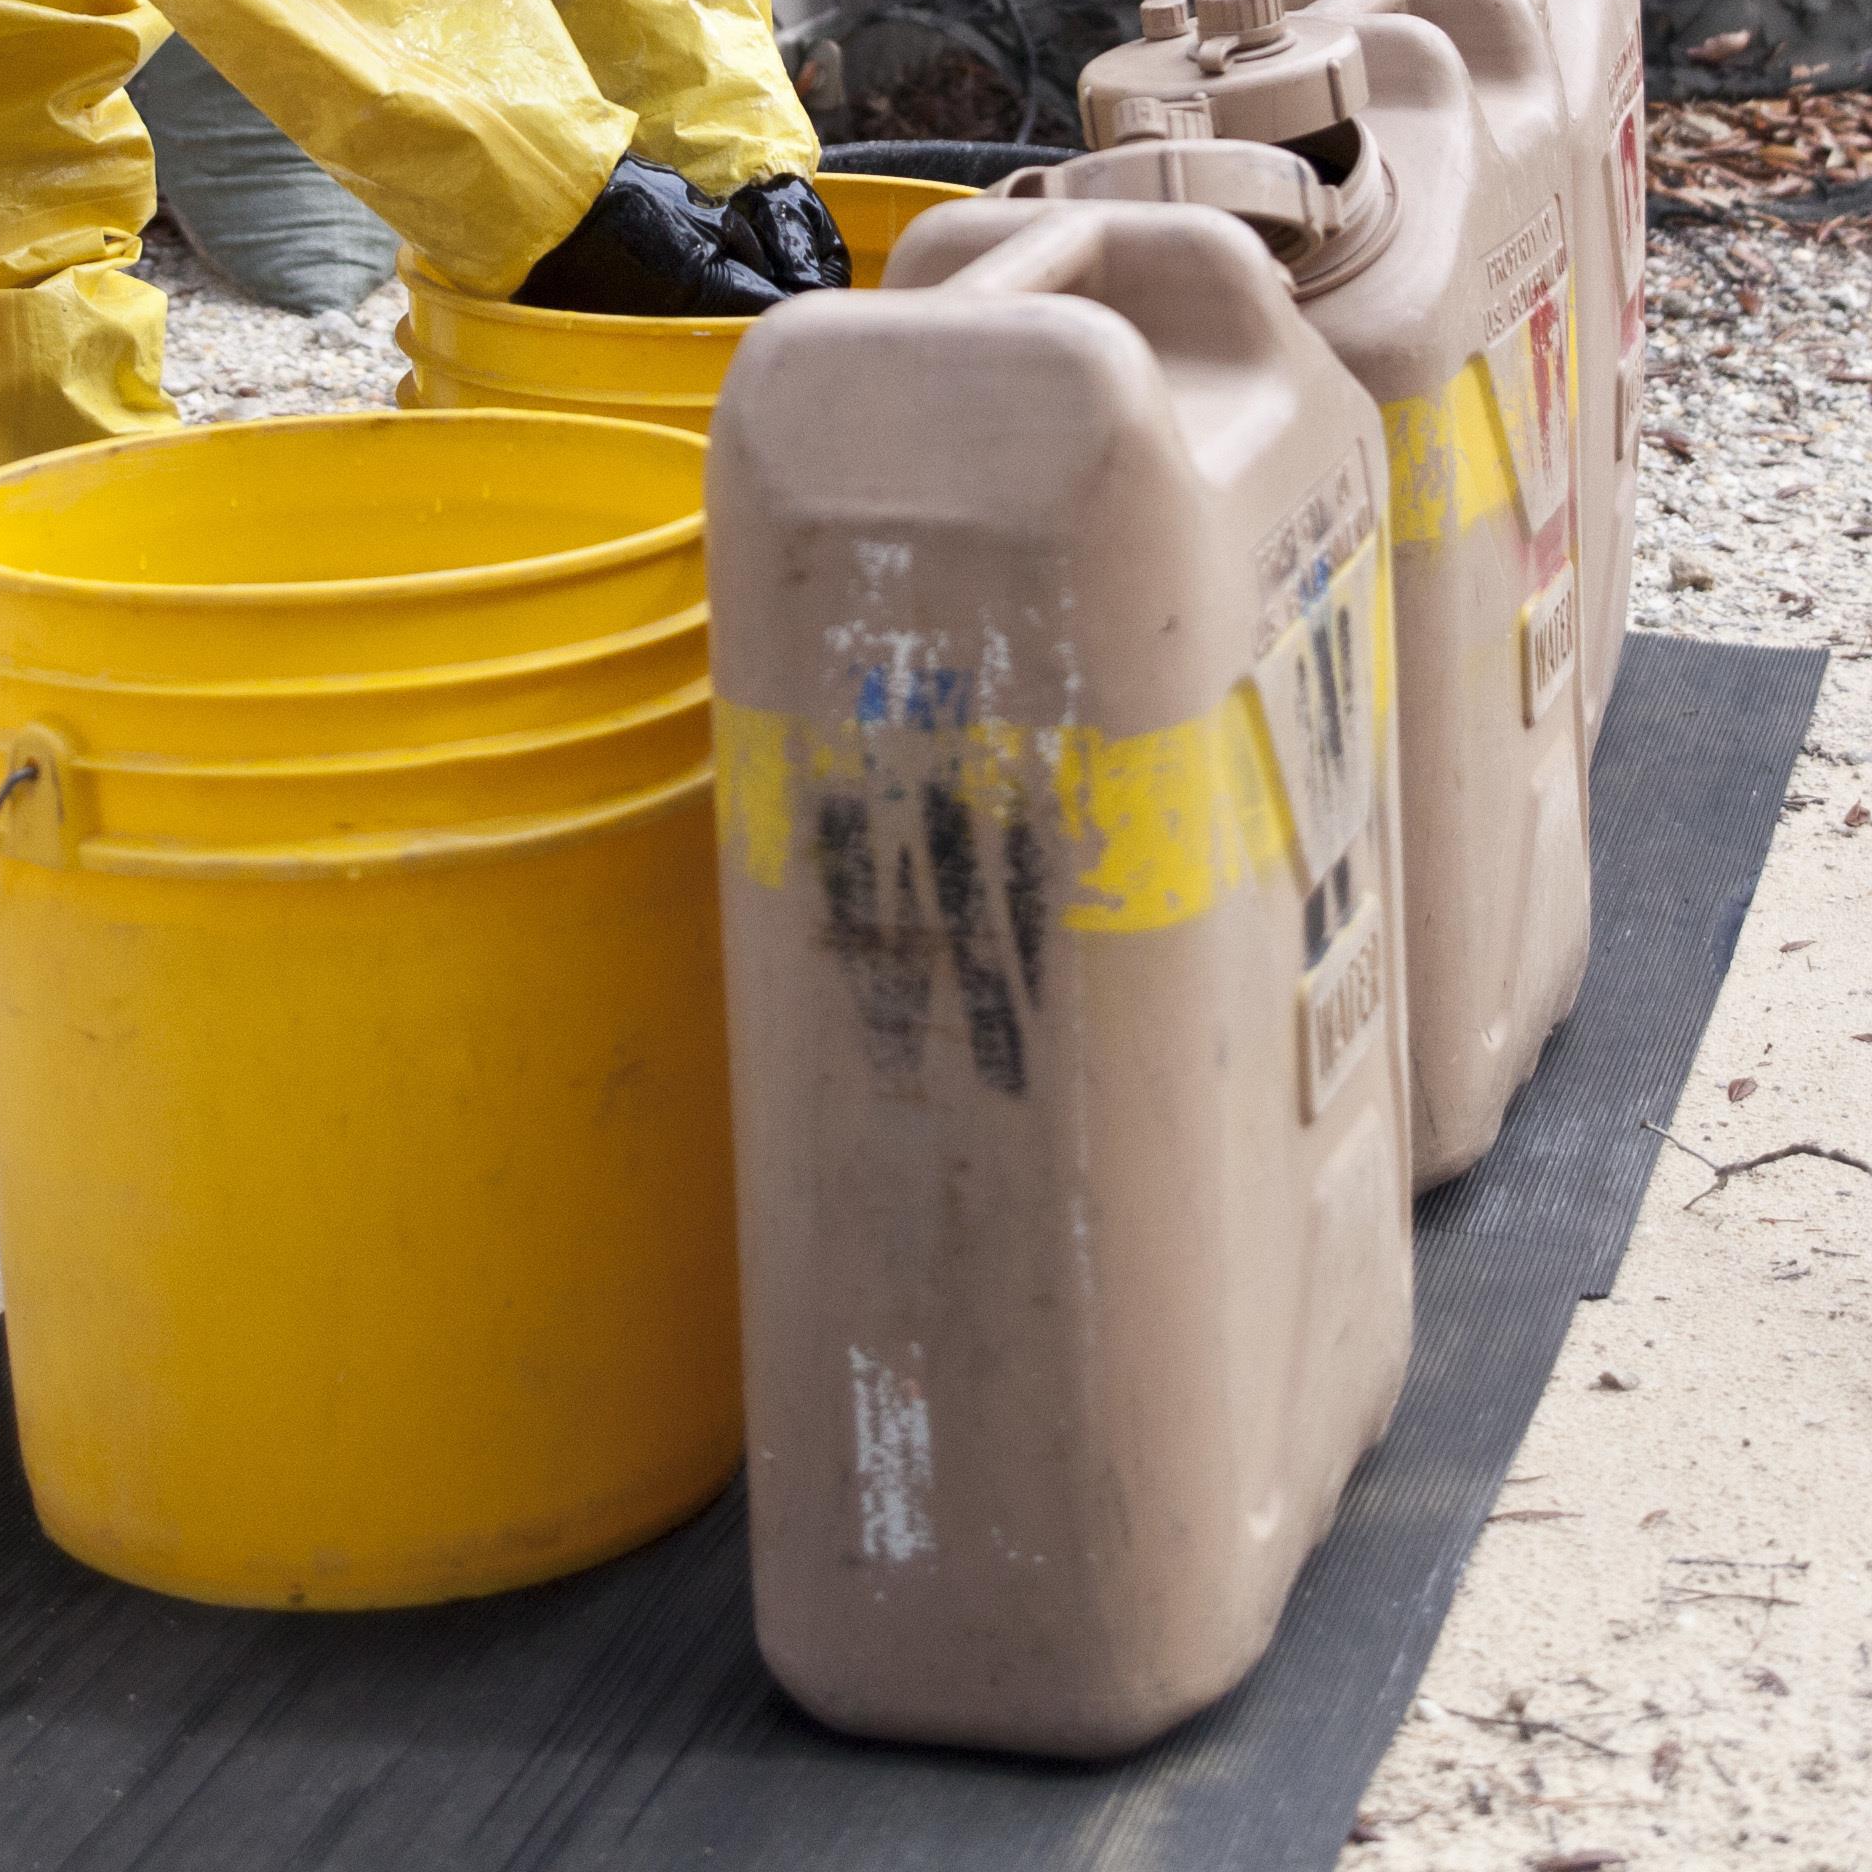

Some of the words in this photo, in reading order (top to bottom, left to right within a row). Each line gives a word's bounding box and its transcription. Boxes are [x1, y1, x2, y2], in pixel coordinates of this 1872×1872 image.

[1485, 227, 1538, 290] PROPERTY
[1533, 588, 1574, 692] WATER
[1314, 930, 1382, 1078] WATER
